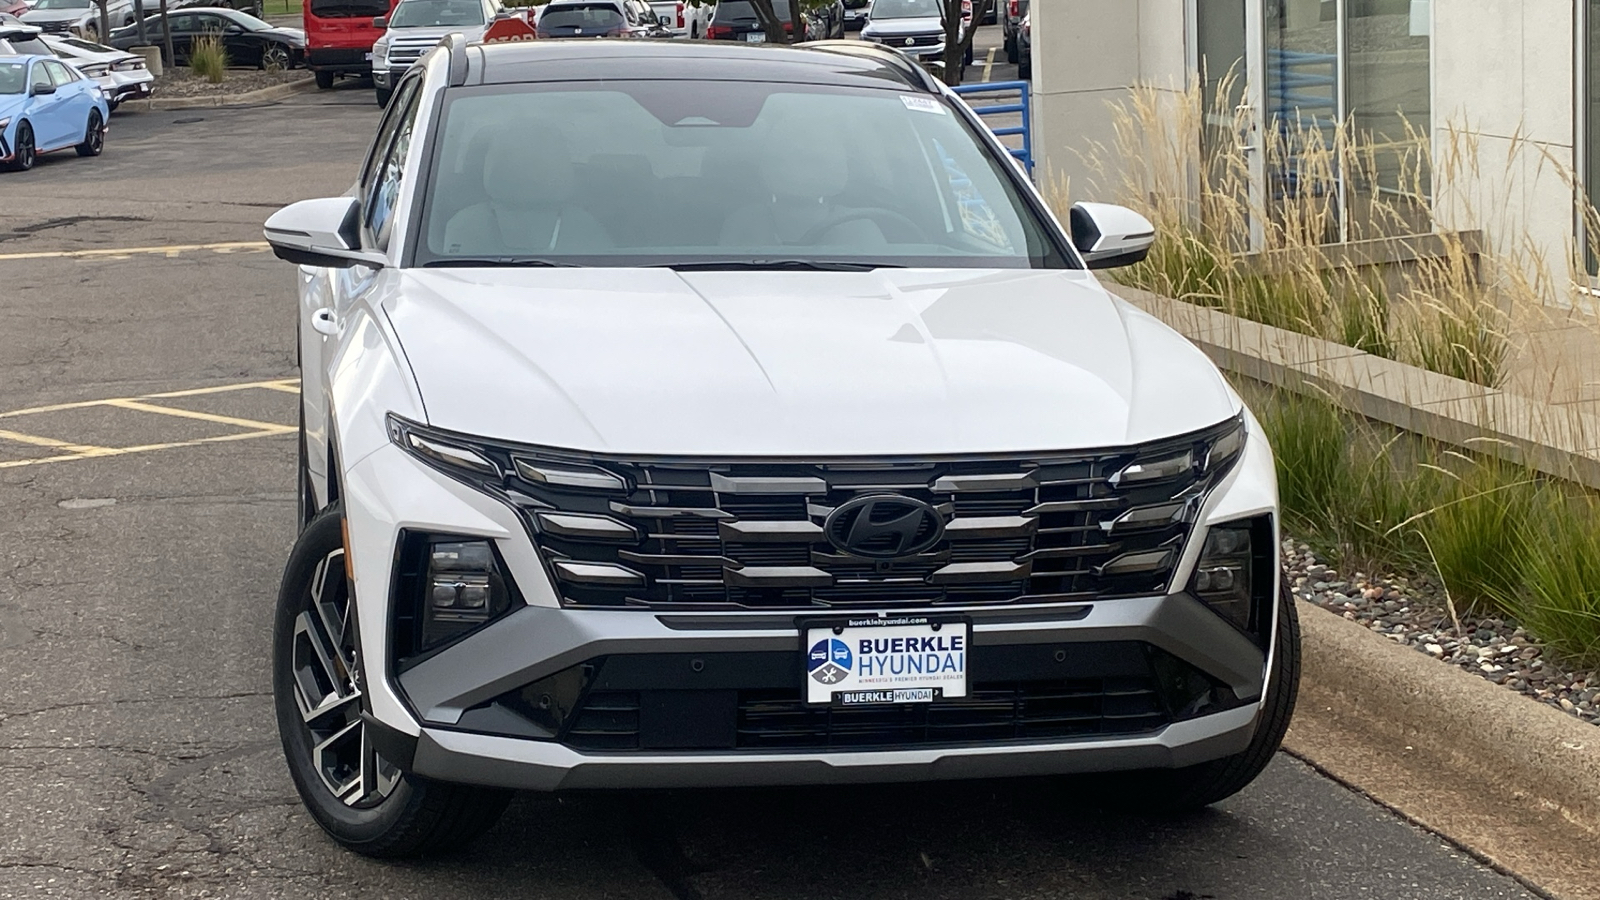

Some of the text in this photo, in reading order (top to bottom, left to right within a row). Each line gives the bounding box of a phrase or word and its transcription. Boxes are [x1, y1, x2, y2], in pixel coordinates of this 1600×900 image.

[849, 618, 927, 626] buerklehyundai.com
[859, 636, 964, 654] BUERKLE
[859, 653, 963, 676] HYUNDAI
[845, 690, 931, 703] BUERKLE HYUNDAI
